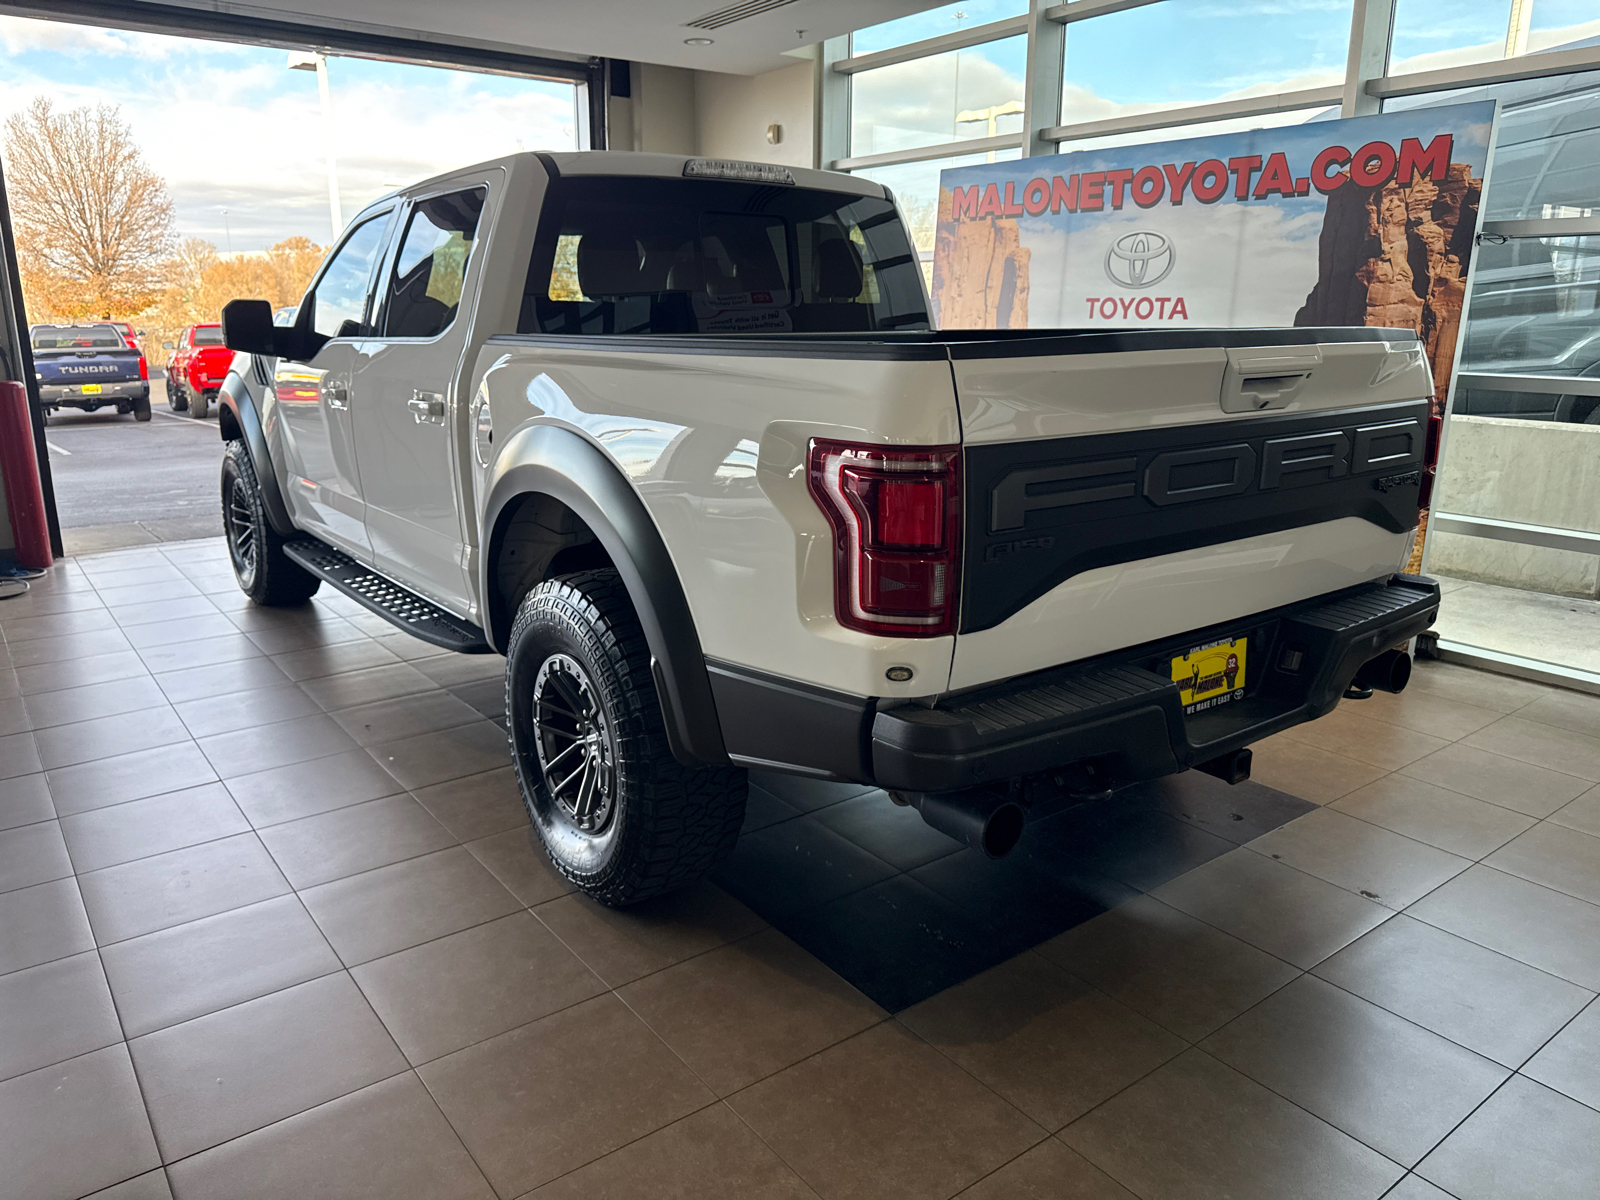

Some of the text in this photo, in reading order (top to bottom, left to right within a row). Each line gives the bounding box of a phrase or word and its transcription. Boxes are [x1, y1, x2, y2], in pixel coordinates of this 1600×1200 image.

[951, 133, 1454, 220] MALONETOYOTA.COM
[1086, 296, 1189, 321] TOYOTA
[58, 365, 119, 374] TUNDRA
[988, 418, 1425, 535] FORD
[1378, 470, 1420, 492] RAPTOR
[1227, 658, 1236, 668] 32
[1187, 694, 1230, 715] WE MAKE IT EASY
